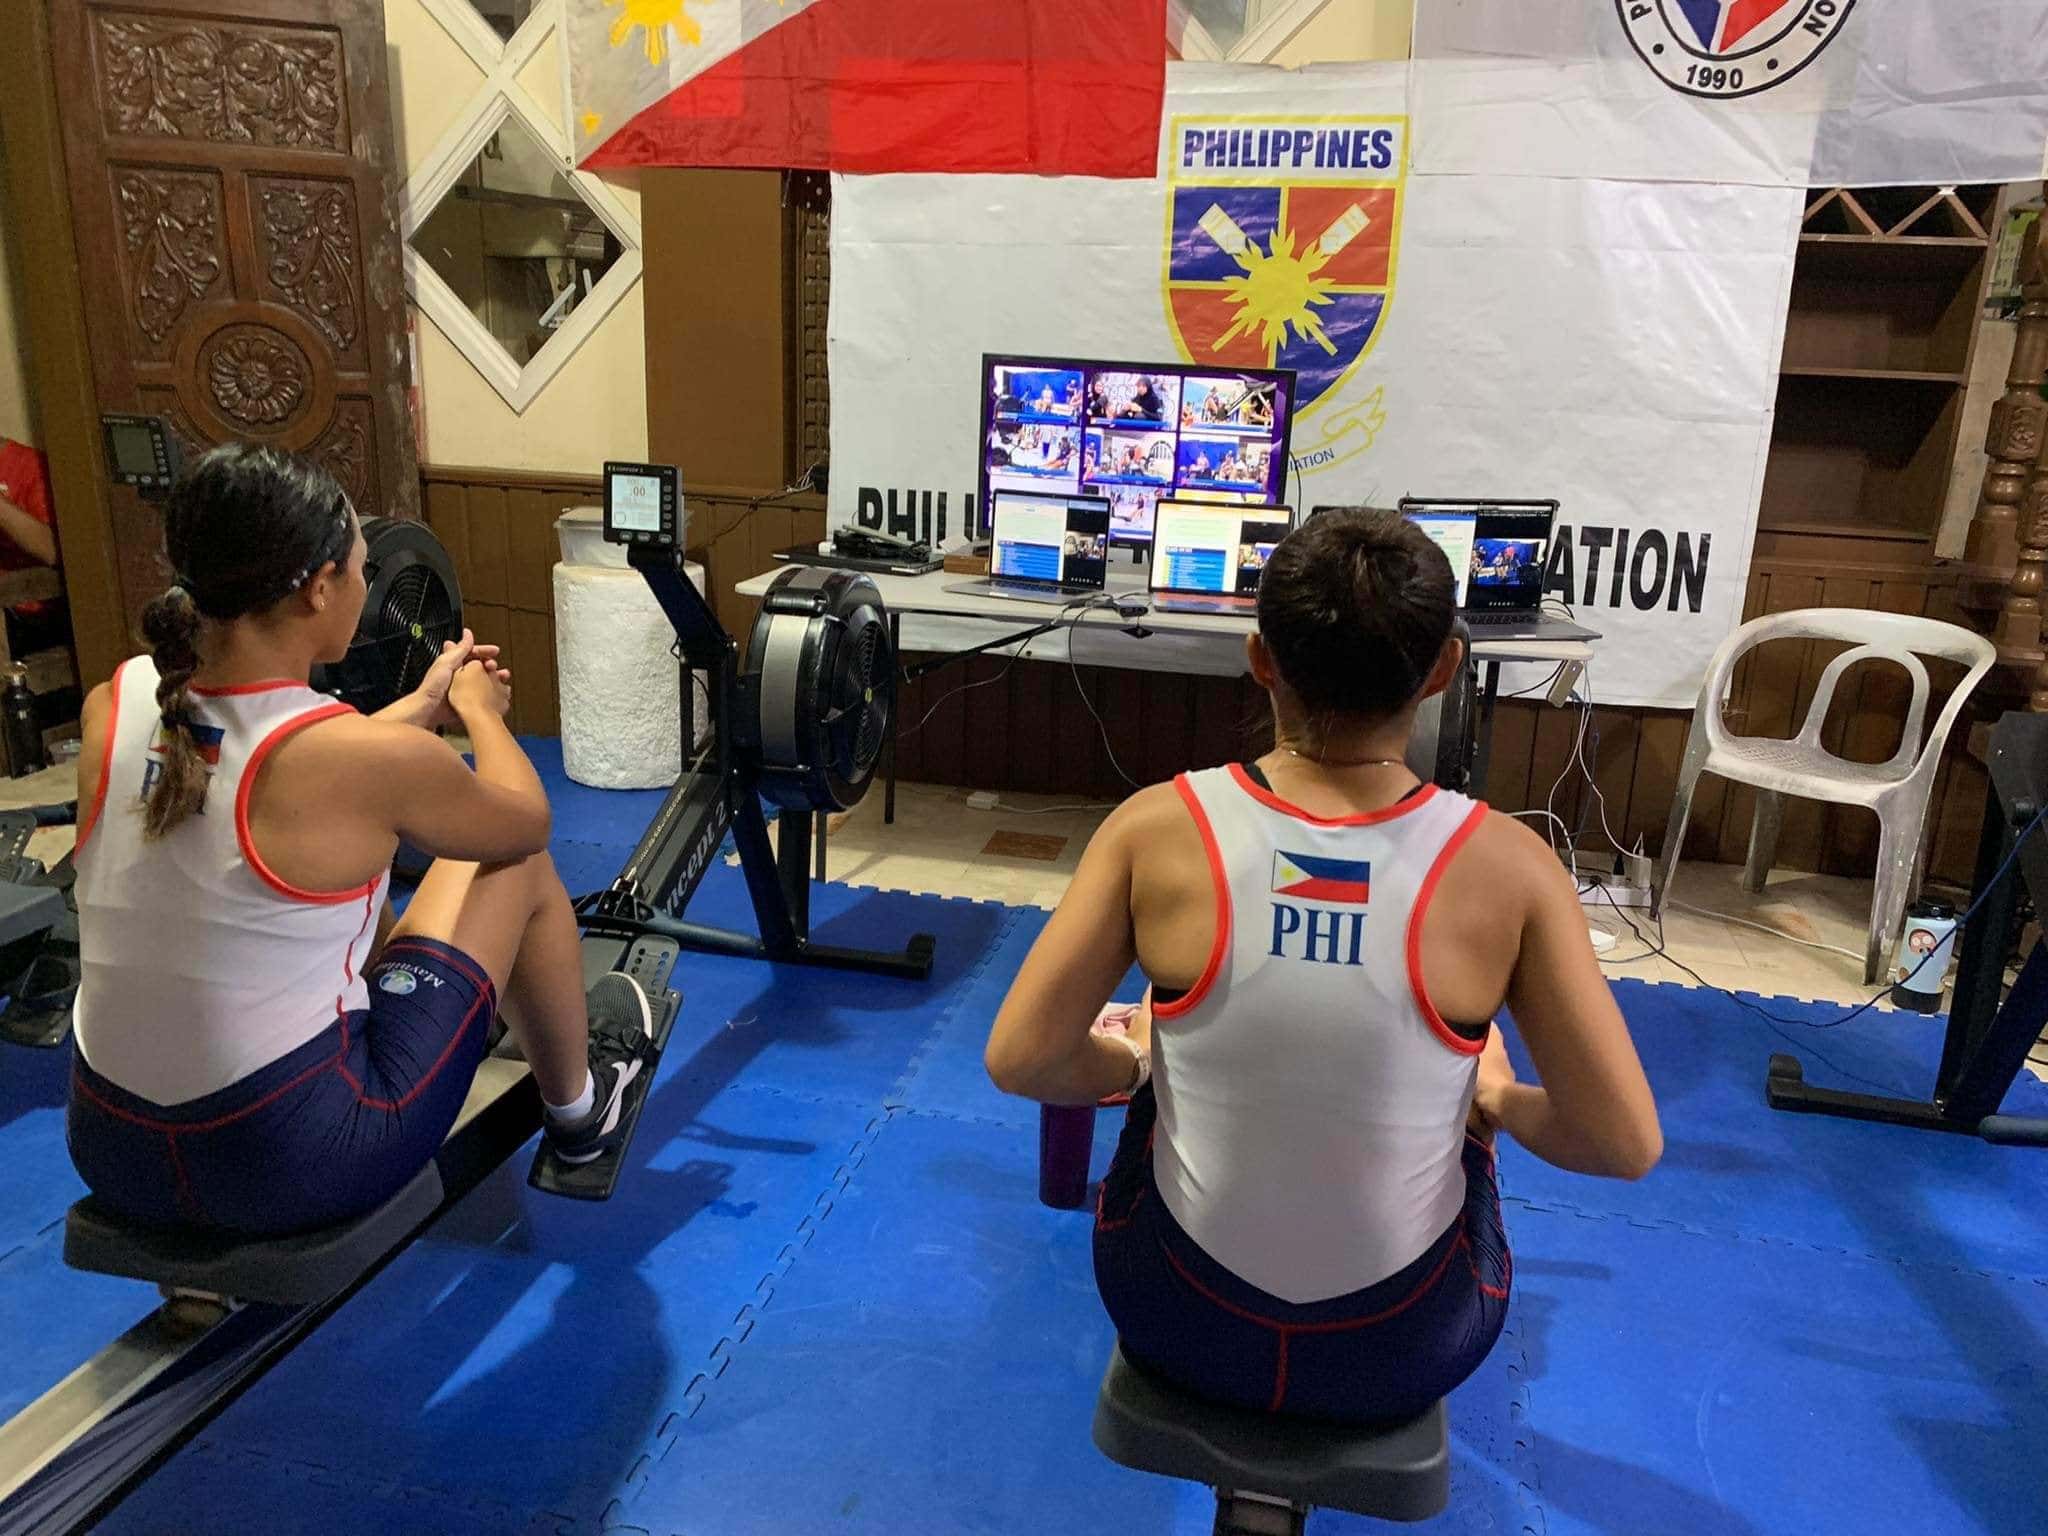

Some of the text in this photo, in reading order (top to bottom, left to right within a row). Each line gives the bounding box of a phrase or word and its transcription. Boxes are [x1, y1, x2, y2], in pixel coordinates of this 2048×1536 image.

[1686, 64, 1743, 90] 1990
[1183, 129, 1393, 169] PHILIPPINES
[1290, 448, 1335, 472] IATION
[1541, 525, 1712, 613] ATION
[662, 821, 717, 919] ncept
[1267, 902, 1368, 966] PHI
